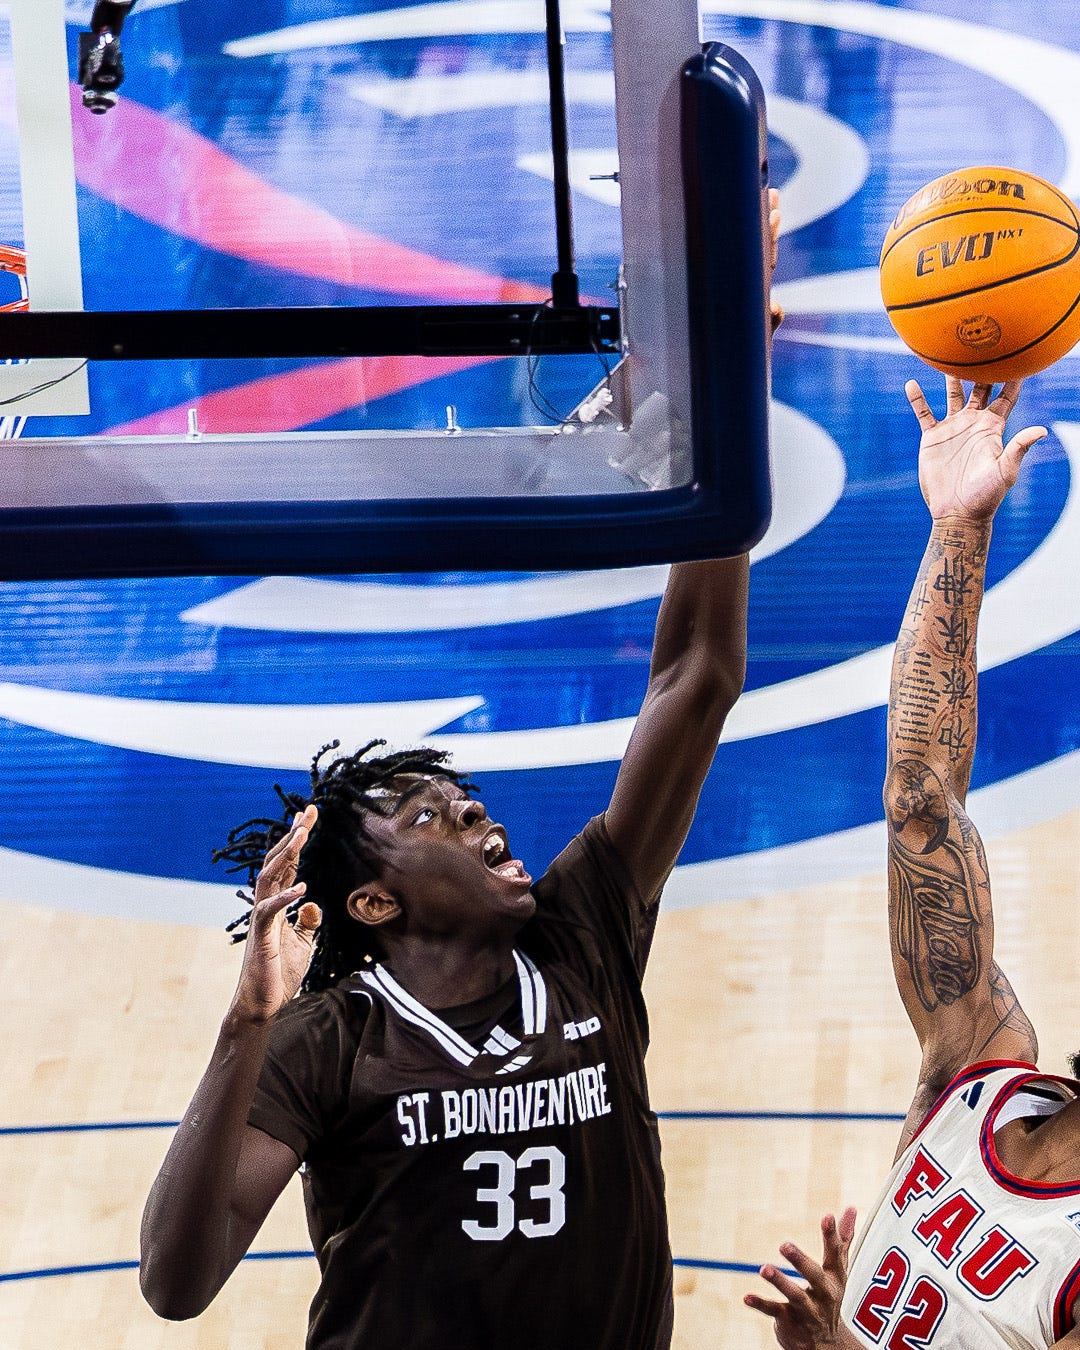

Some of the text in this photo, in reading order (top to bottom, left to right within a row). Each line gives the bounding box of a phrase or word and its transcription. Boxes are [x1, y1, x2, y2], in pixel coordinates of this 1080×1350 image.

[915, 228, 1024, 277] EVO NXT
[397, 1062, 612, 1146] ST. BONAVENTURE
[461, 1145, 566, 1241] 33
[890, 1143, 1040, 1303] FAU
